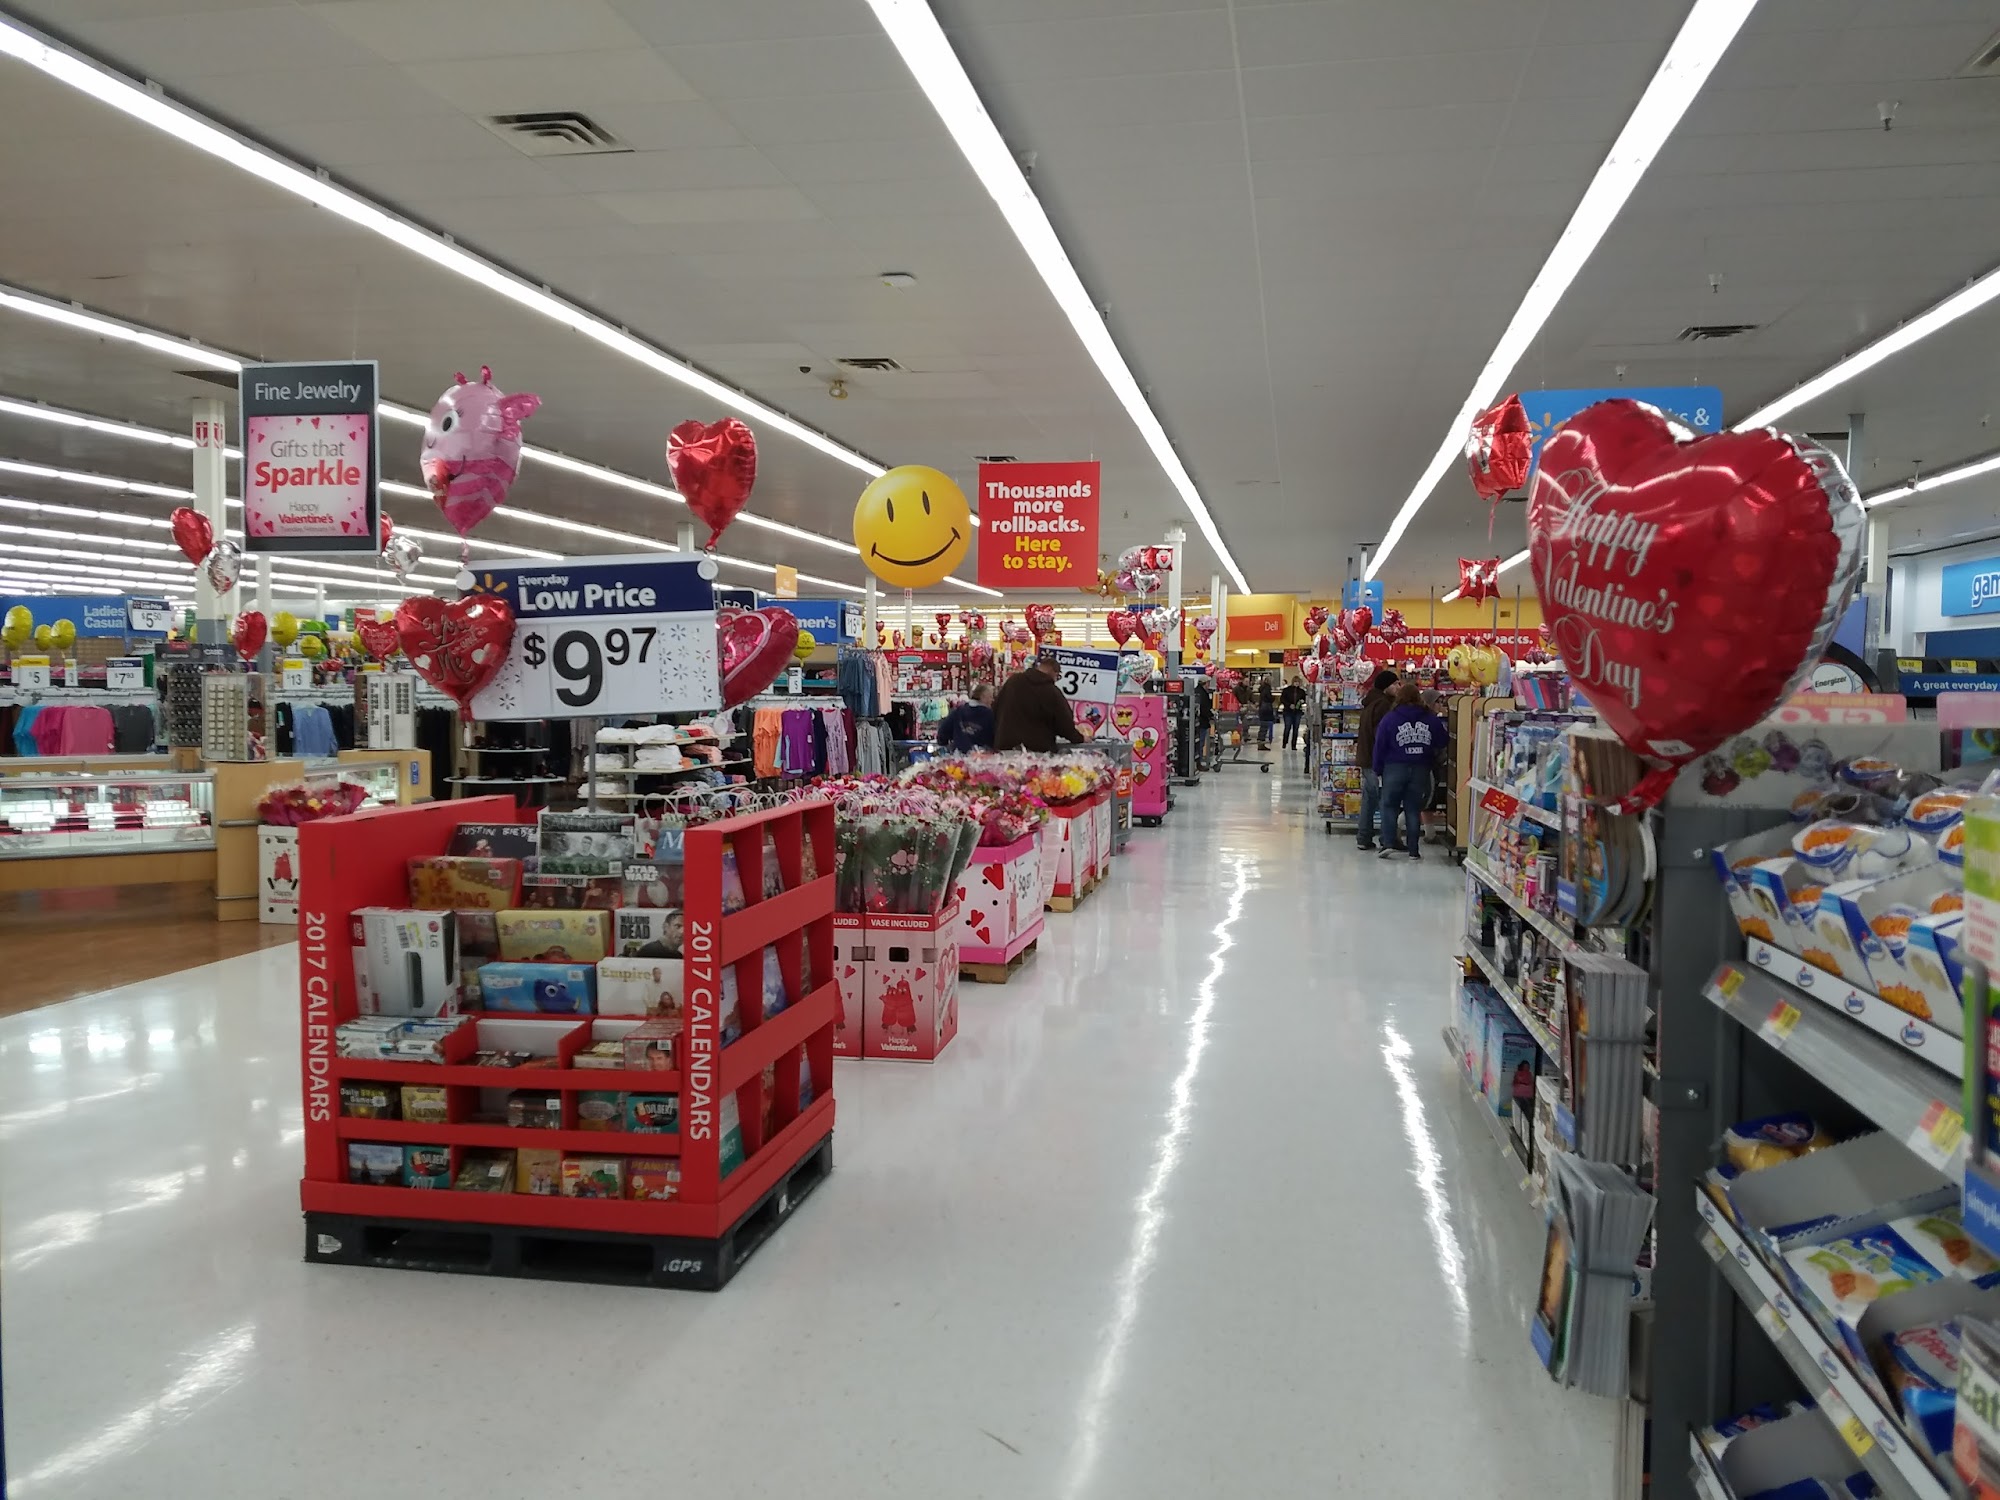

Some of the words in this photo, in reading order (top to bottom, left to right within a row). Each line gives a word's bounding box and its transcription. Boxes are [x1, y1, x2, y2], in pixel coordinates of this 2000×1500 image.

[255, 382, 291, 401] Fine
[295, 380, 361, 403] Jewelry
[270, 440, 308, 458] Gifts
[313, 439, 345, 457] that
[255, 459, 361, 493] Sparkle
[986, 481, 1092, 499] Thousands
[289, 502, 319, 513] Happy
[1013, 500, 1064, 514] more
[278, 513, 334, 524] Valentine's
[991, 516, 1085, 533] rollbacks.
[1551, 467, 1658, 576] Happy
[1015, 537, 1061, 552] Here
[1003, 554, 1021, 569] to
[1024, 554, 1072, 573] stay.
[517, 574, 570, 587] Everyday
[1532, 529, 1678, 633] Valentine's
[518, 587, 579, 612] Low
[584, 583, 657, 608] Price
[84, 606, 126, 617] Ladies
[84, 617, 126, 629] Casual
[1264, 621, 1279, 632] Deli
[1405, 645, 1434, 656] Here
[1056, 654, 1074, 664] Low
[1076, 656, 1100, 668] Price
[1555, 613, 1641, 709] Day
[1815, 675, 1848, 688] Energizer
[1913, 680, 1921, 690] A
[1923, 681, 1949, 691] great
[1952, 680, 1998, 692] everyday
[458, 826, 496, 837] JUSTIN
[629, 865, 657, 873] STAR
[625, 872, 659, 882] WARS
[620, 916, 650, 925] WALKING
[871, 919, 890, 927] VASE
[891, 919, 929, 928] INCLUDED
[620, 924, 651, 940] DEAD
[306, 912, 326, 971] 2017
[429, 934, 438, 948] LG
[692, 922, 712, 981] 2017
[601, 967, 652, 983] Empire
[881, 1043, 918, 1052] Valentine's
[888, 1036, 909, 1045] Happy
[308, 977, 330, 1122] CALENDARS
[689, 988, 712, 1140] CALENDARS
[340, 1087, 359, 1097] Daily
